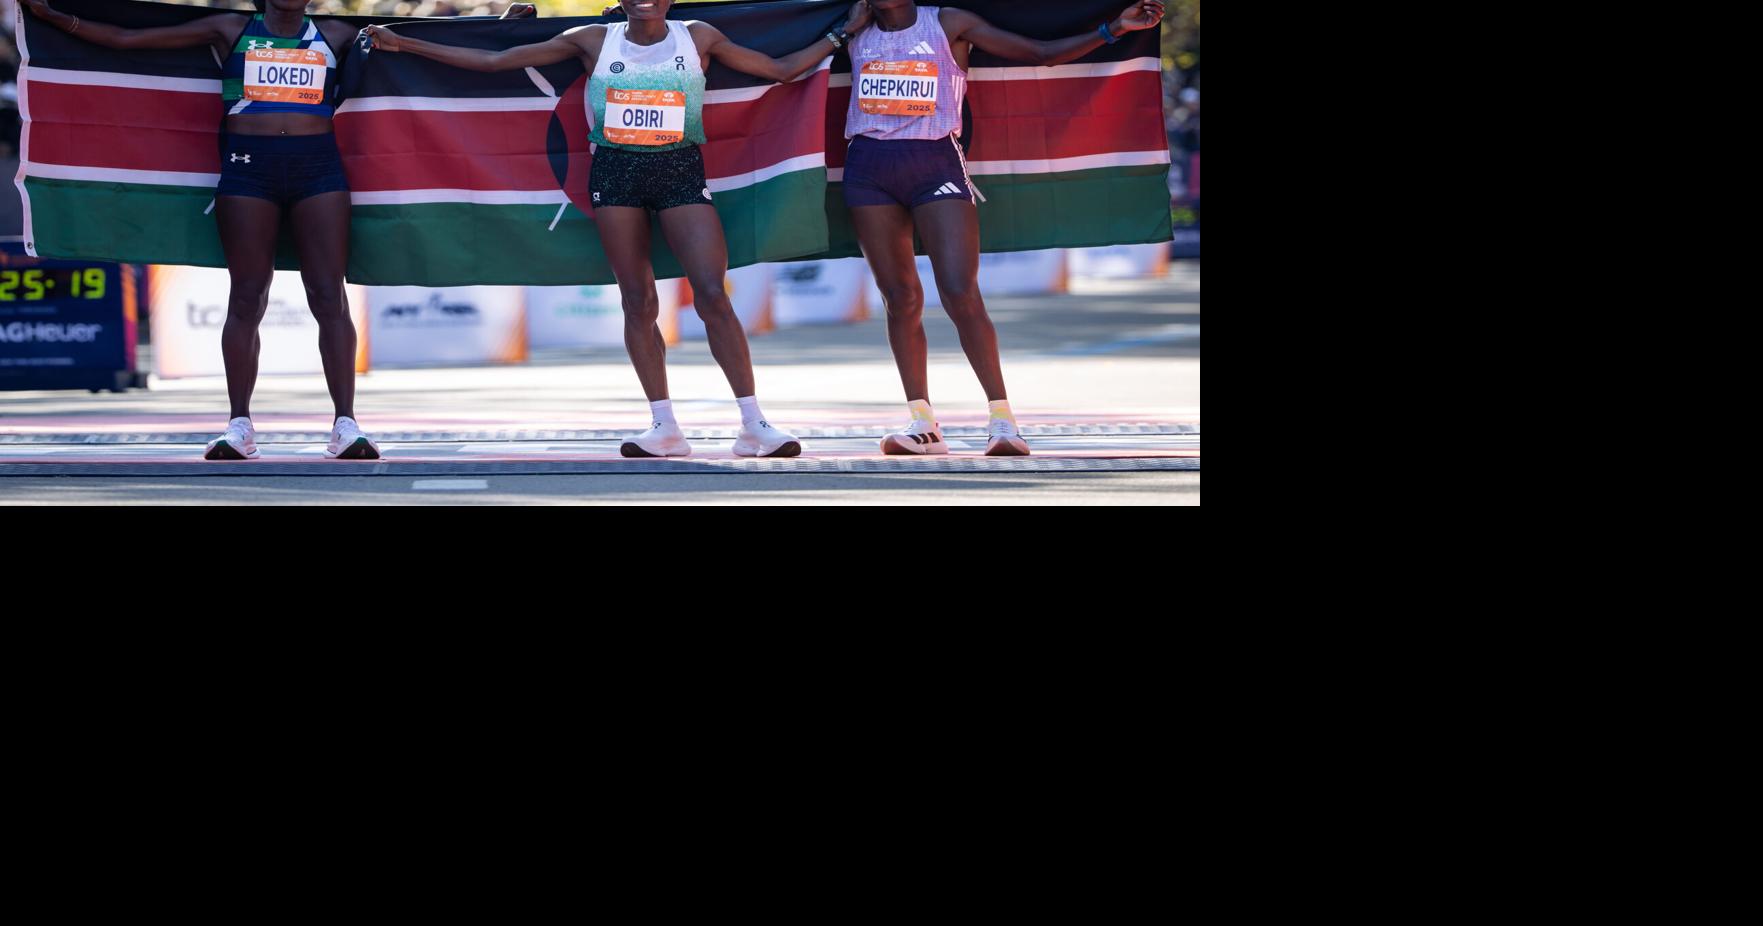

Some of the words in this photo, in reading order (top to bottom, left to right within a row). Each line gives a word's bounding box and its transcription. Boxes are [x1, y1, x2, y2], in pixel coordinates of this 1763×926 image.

[258, 66, 314, 86] LOKEDI
[298, 92, 319, 100] 2025
[861, 78, 934, 98] CHEPKIRUI
[622, 108, 664, 128] OBIRI
[906, 104, 930, 112] 2025
[655, 134, 679, 142] 2025
[187, 299, 226, 329] tc
